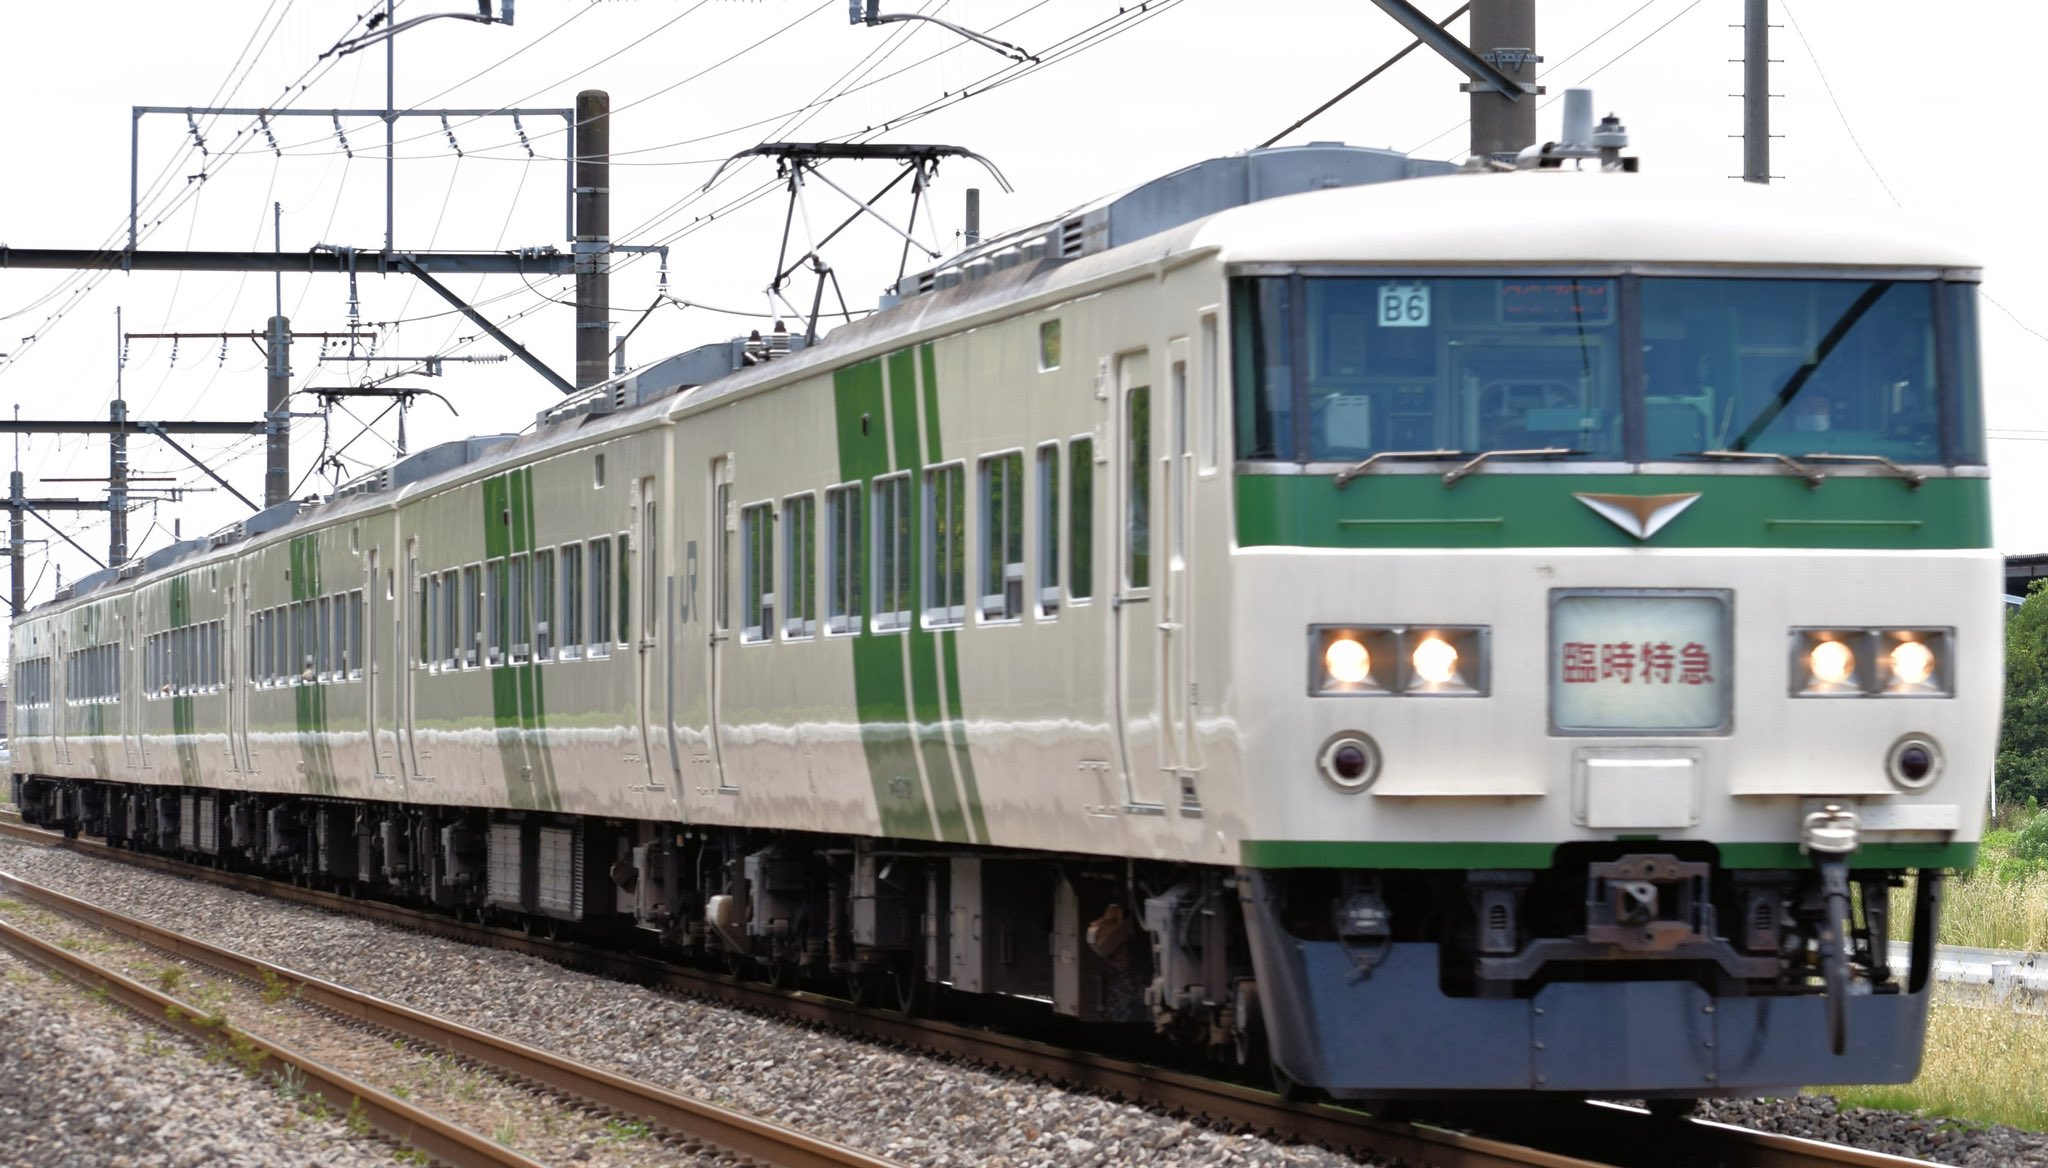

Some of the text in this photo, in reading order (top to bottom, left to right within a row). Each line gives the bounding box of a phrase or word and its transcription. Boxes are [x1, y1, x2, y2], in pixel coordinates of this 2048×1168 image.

[1384, 295, 1425, 322] B6
[681, 540, 698, 624] JR
[1563, 642, 1714, 685] 臨時特急
